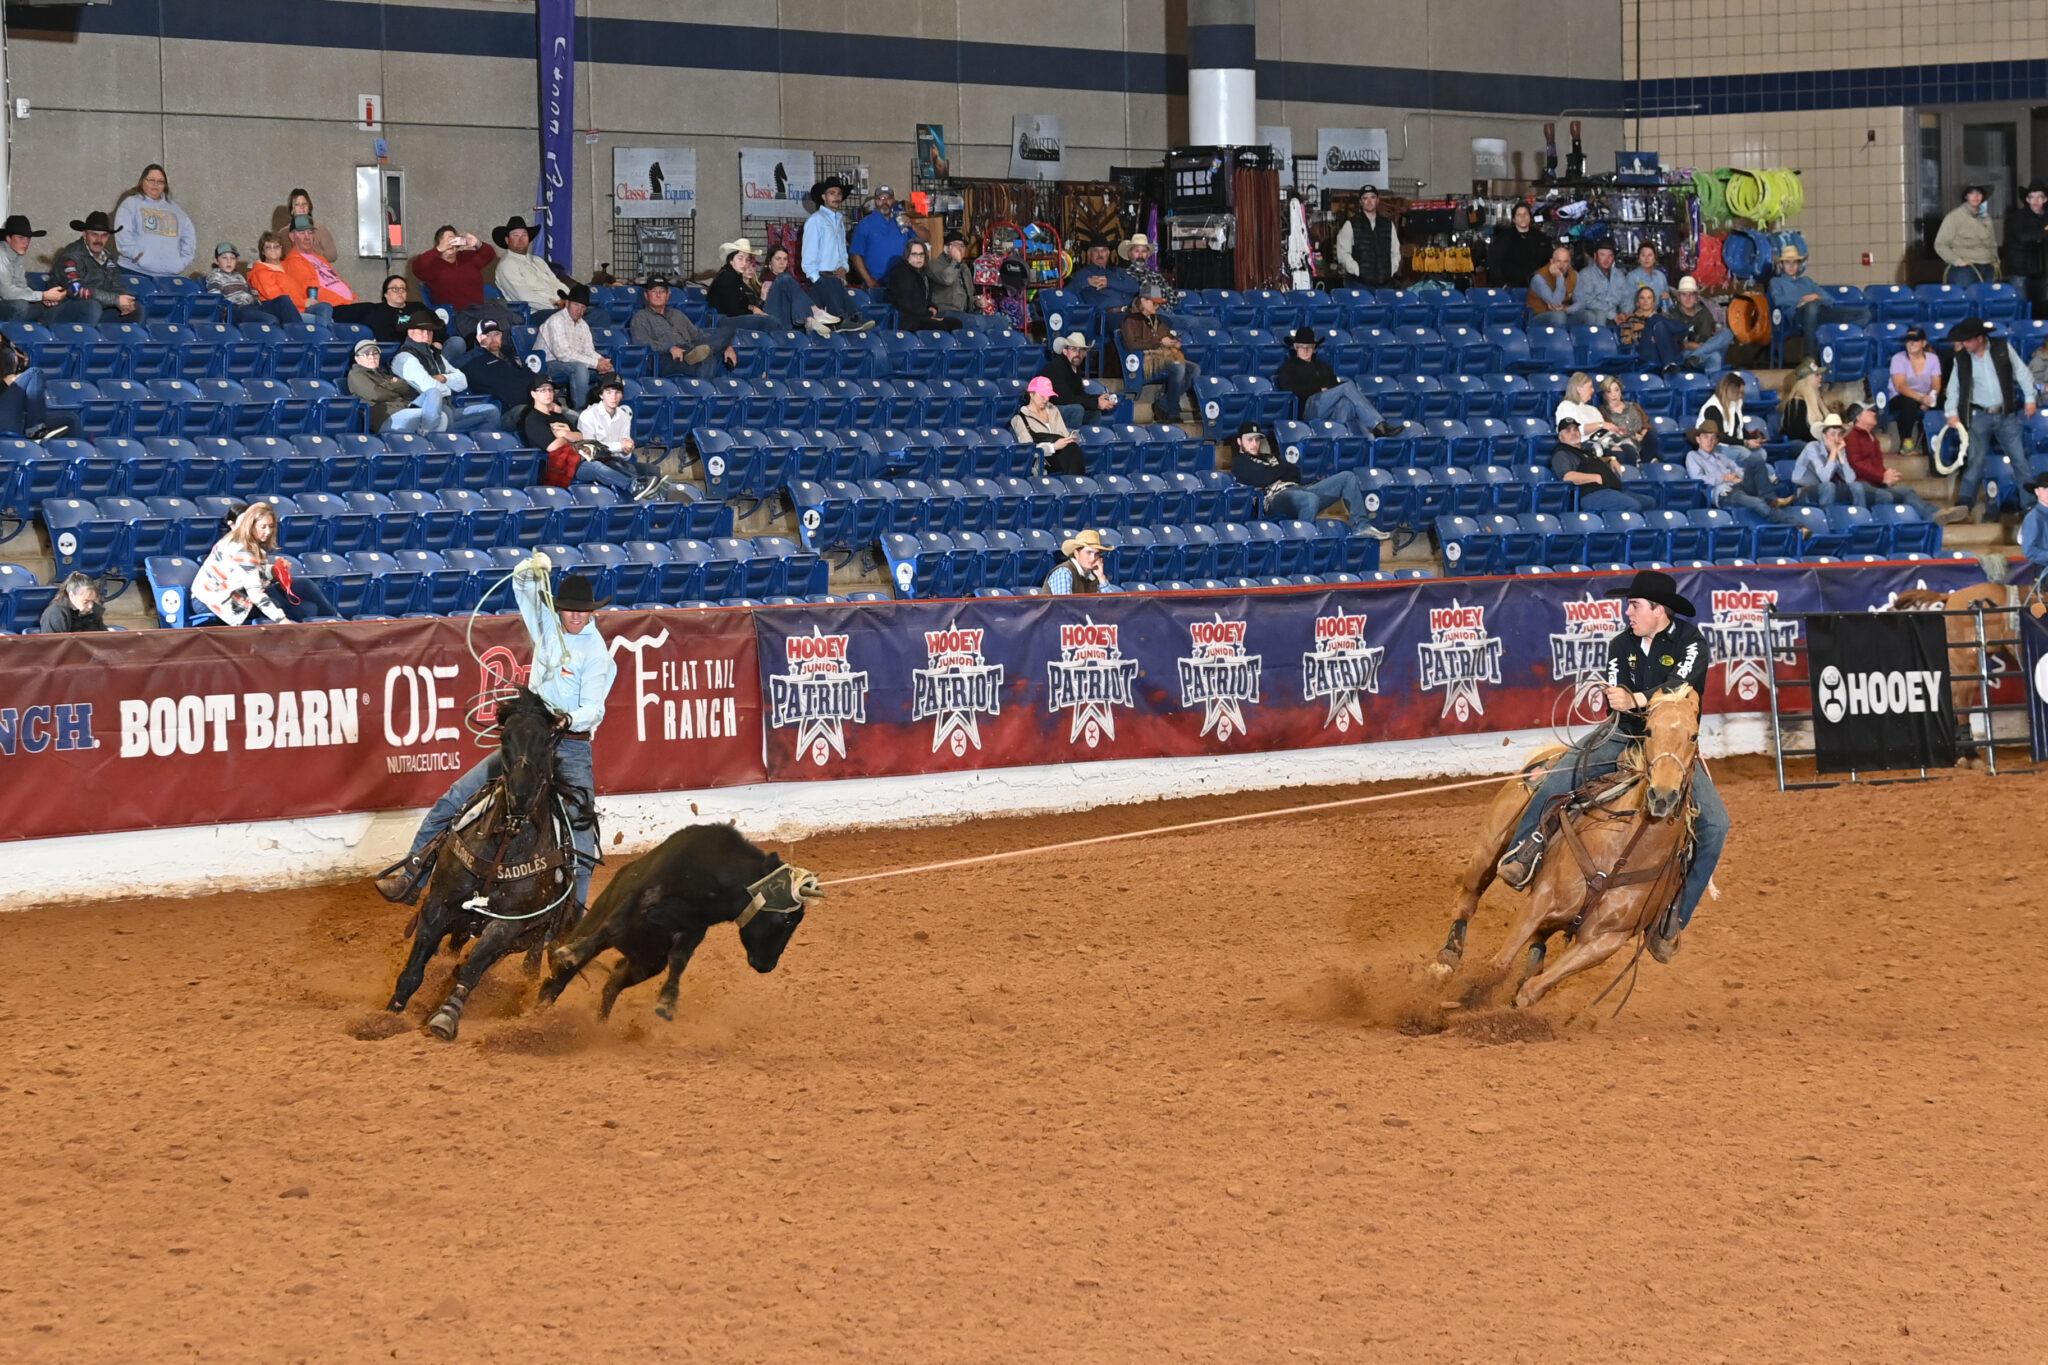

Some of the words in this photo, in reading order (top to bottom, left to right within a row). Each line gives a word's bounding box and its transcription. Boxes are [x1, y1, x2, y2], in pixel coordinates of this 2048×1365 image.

[1341, 149, 1381, 164] MARTIN
[616, 183, 648, 200] Classic
[664, 183, 694, 204] Equine
[745, 182, 773, 200] Classic
[1565, 601, 1621, 621] HOOEY
[1714, 591, 1776, 610] HOOEY
[1316, 616, 1366, 637] HOOEY
[1431, 608, 1484, 630] HOOEY
[1728, 613, 1764, 623] JUNIOR
[1062, 626, 1117, 647] HOOEY
[1191, 622, 1246, 643] HOOEY
[1443, 631, 1477, 642] JUNIOR
[1581, 624, 1615, 634] JUNIOR
[787, 635, 848, 659] HOOEY
[926, 630, 983, 654] HOOEY
[1205, 647, 1234, 658] JUNIOR
[1327, 640, 1357, 652] JUNIOR
[938, 656, 974, 669] JUNIOR
[1074, 650, 1106, 661] JUNIOR
[1419, 641, 1501, 690] PATRIOT
[1551, 637, 1608, 676] PATR
[662, 660, 698, 691] FLAT
[704, 659, 735, 689] TAIL
[802, 662, 838, 675] JUNIOR
[1304, 650, 1383, 699] PATRIOT
[1049, 663, 1137, 711] PATRIOT
[1179, 658, 1260, 706] PATRIOT
[1847, 670, 1942, 715] HOOEY
[771, 674, 867, 726] PATRIOT
[913, 669, 1003, 720] PATRIOT
[119, 694, 236, 758] BOOT
[664, 697, 737, 741] RANCH
[386, 752, 460, 774] NUTRACEUTICALS
[497, 857, 548, 879] SADDLES
